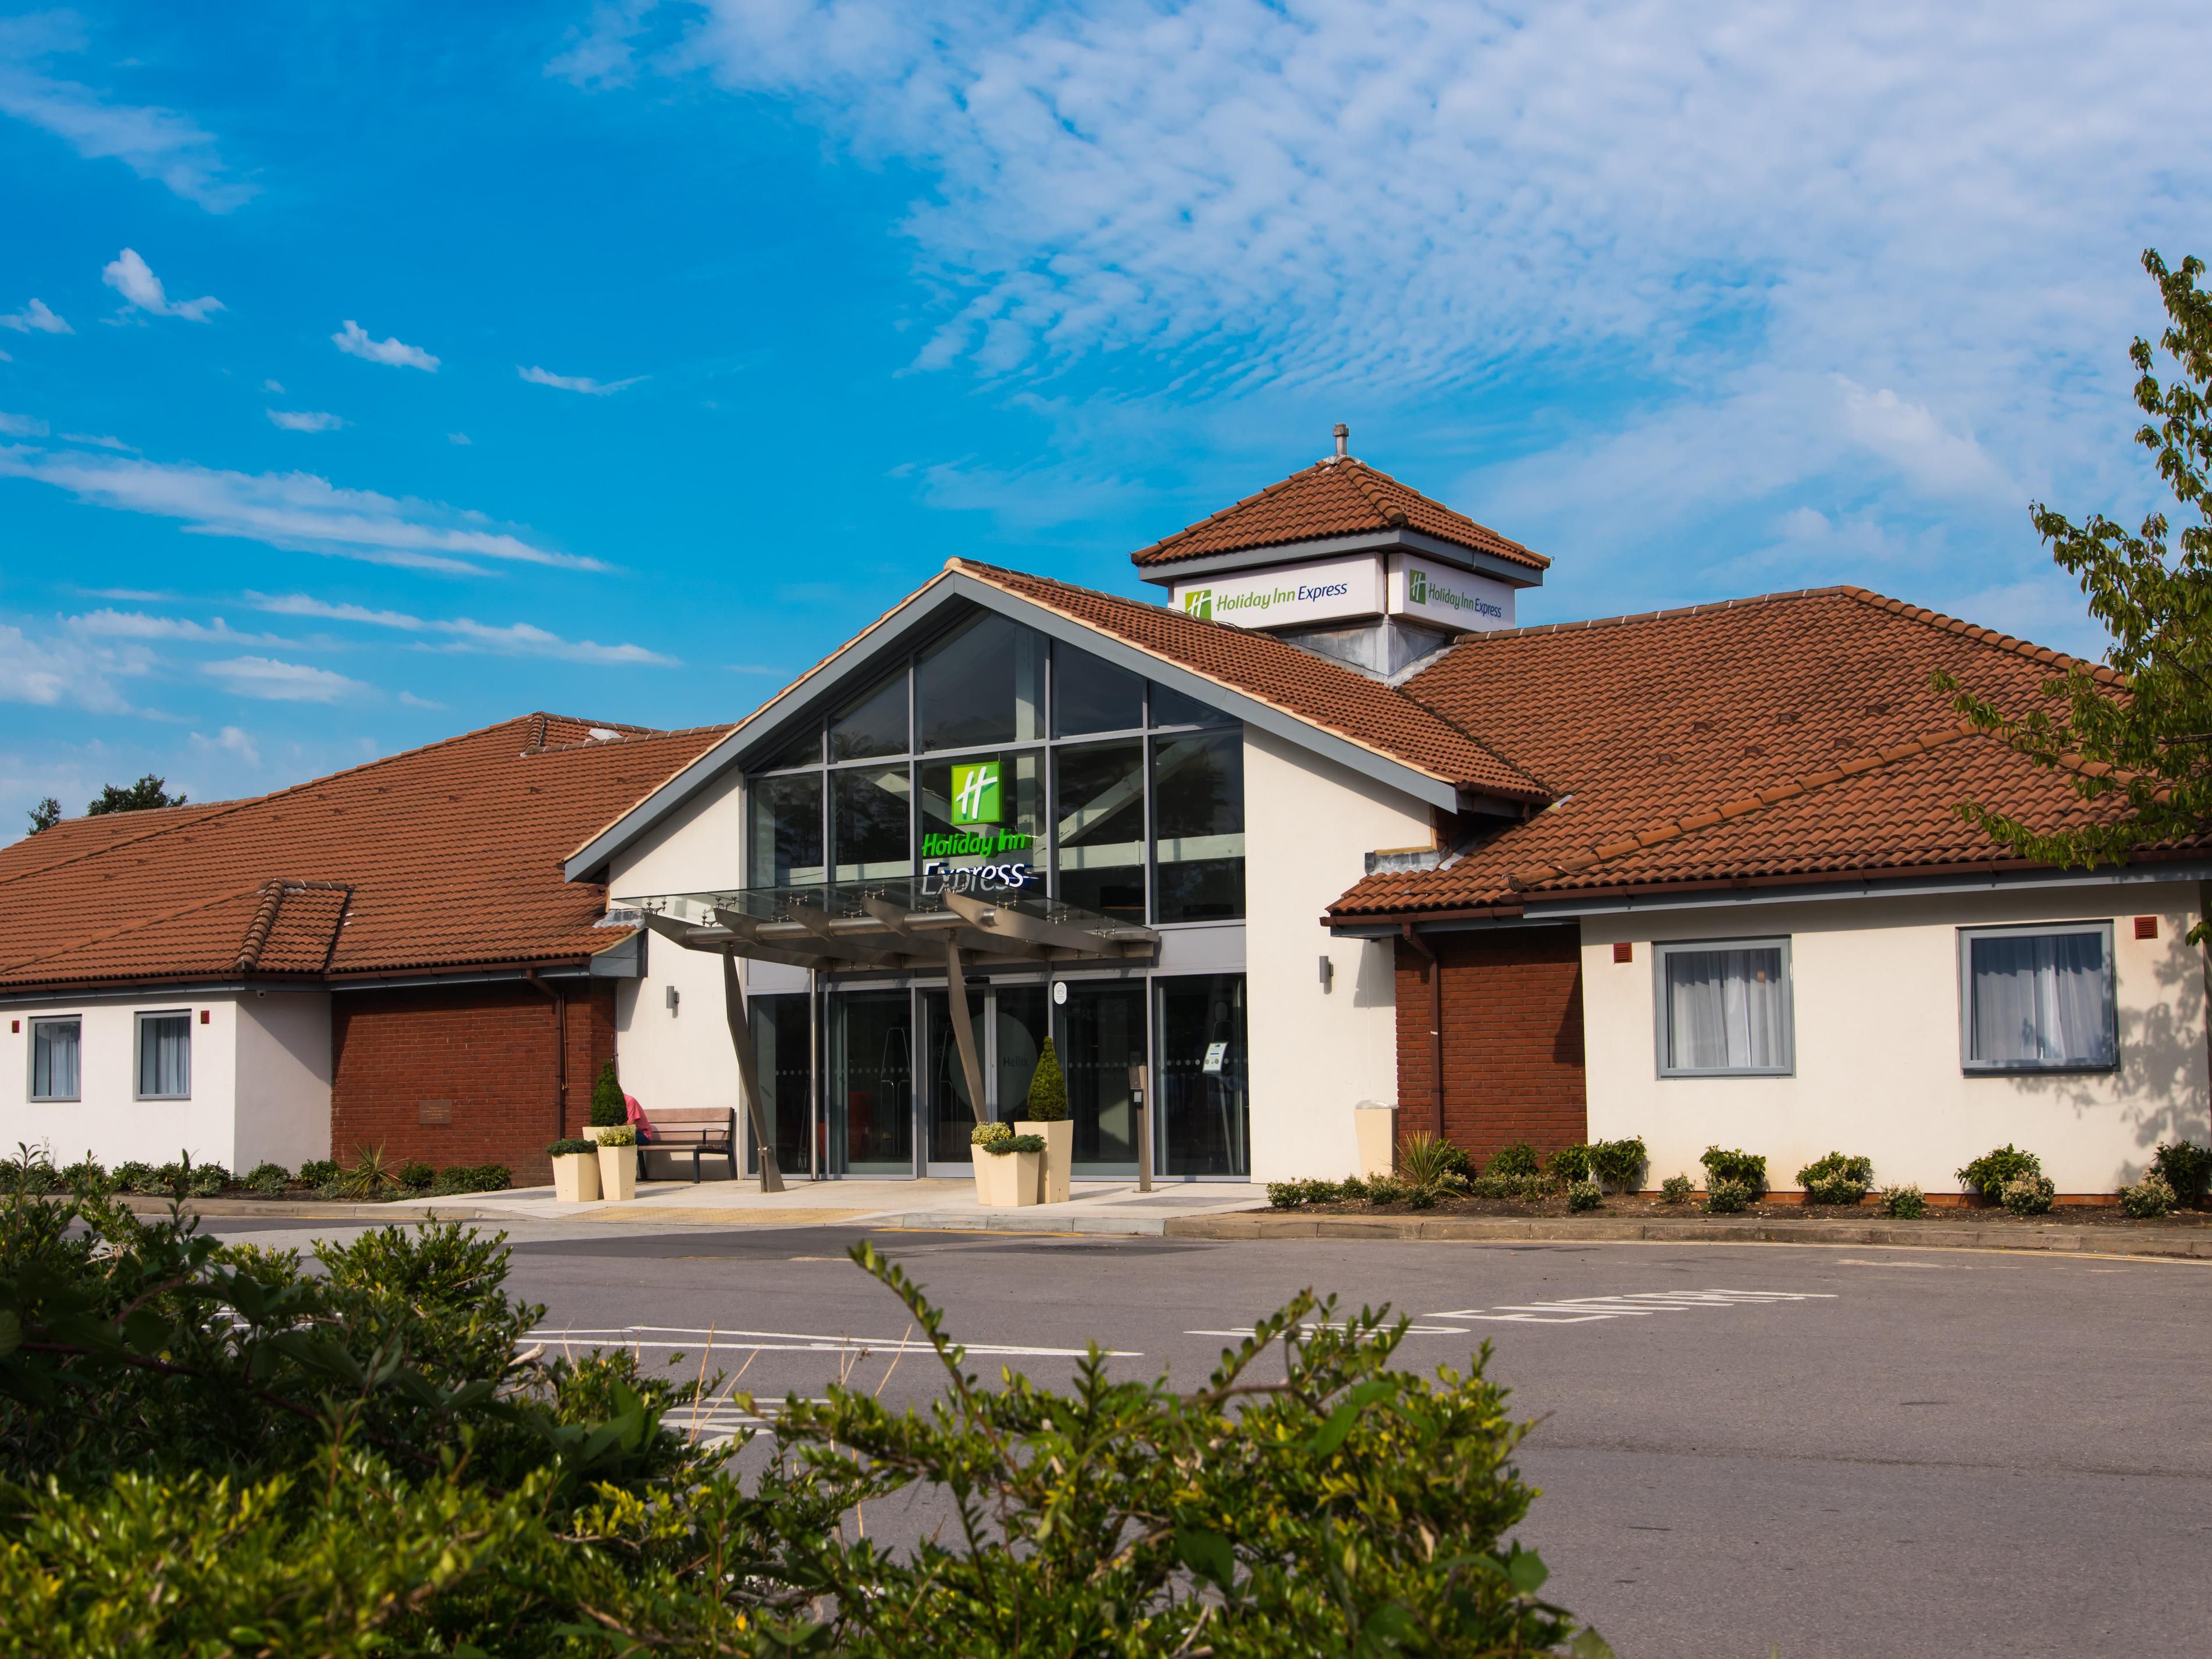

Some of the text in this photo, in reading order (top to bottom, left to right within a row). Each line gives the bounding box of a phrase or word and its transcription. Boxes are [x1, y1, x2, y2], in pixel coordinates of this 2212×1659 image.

[1216, 591, 1271, 611] Holiday
[1273, 588, 1295, 604] Inn
[1298, 583, 1348, 602] Express
[1429, 582, 1461, 610] Holiday
[1461, 592, 1474, 610] Inn
[1474, 598, 1502, 618] Express
[956, 766, 998, 820] H
[922, 828, 1030, 858] Holiday Inn
[922, 862, 1025, 895] Express
[1421, 1289, 1839, 1323] ENTRY
